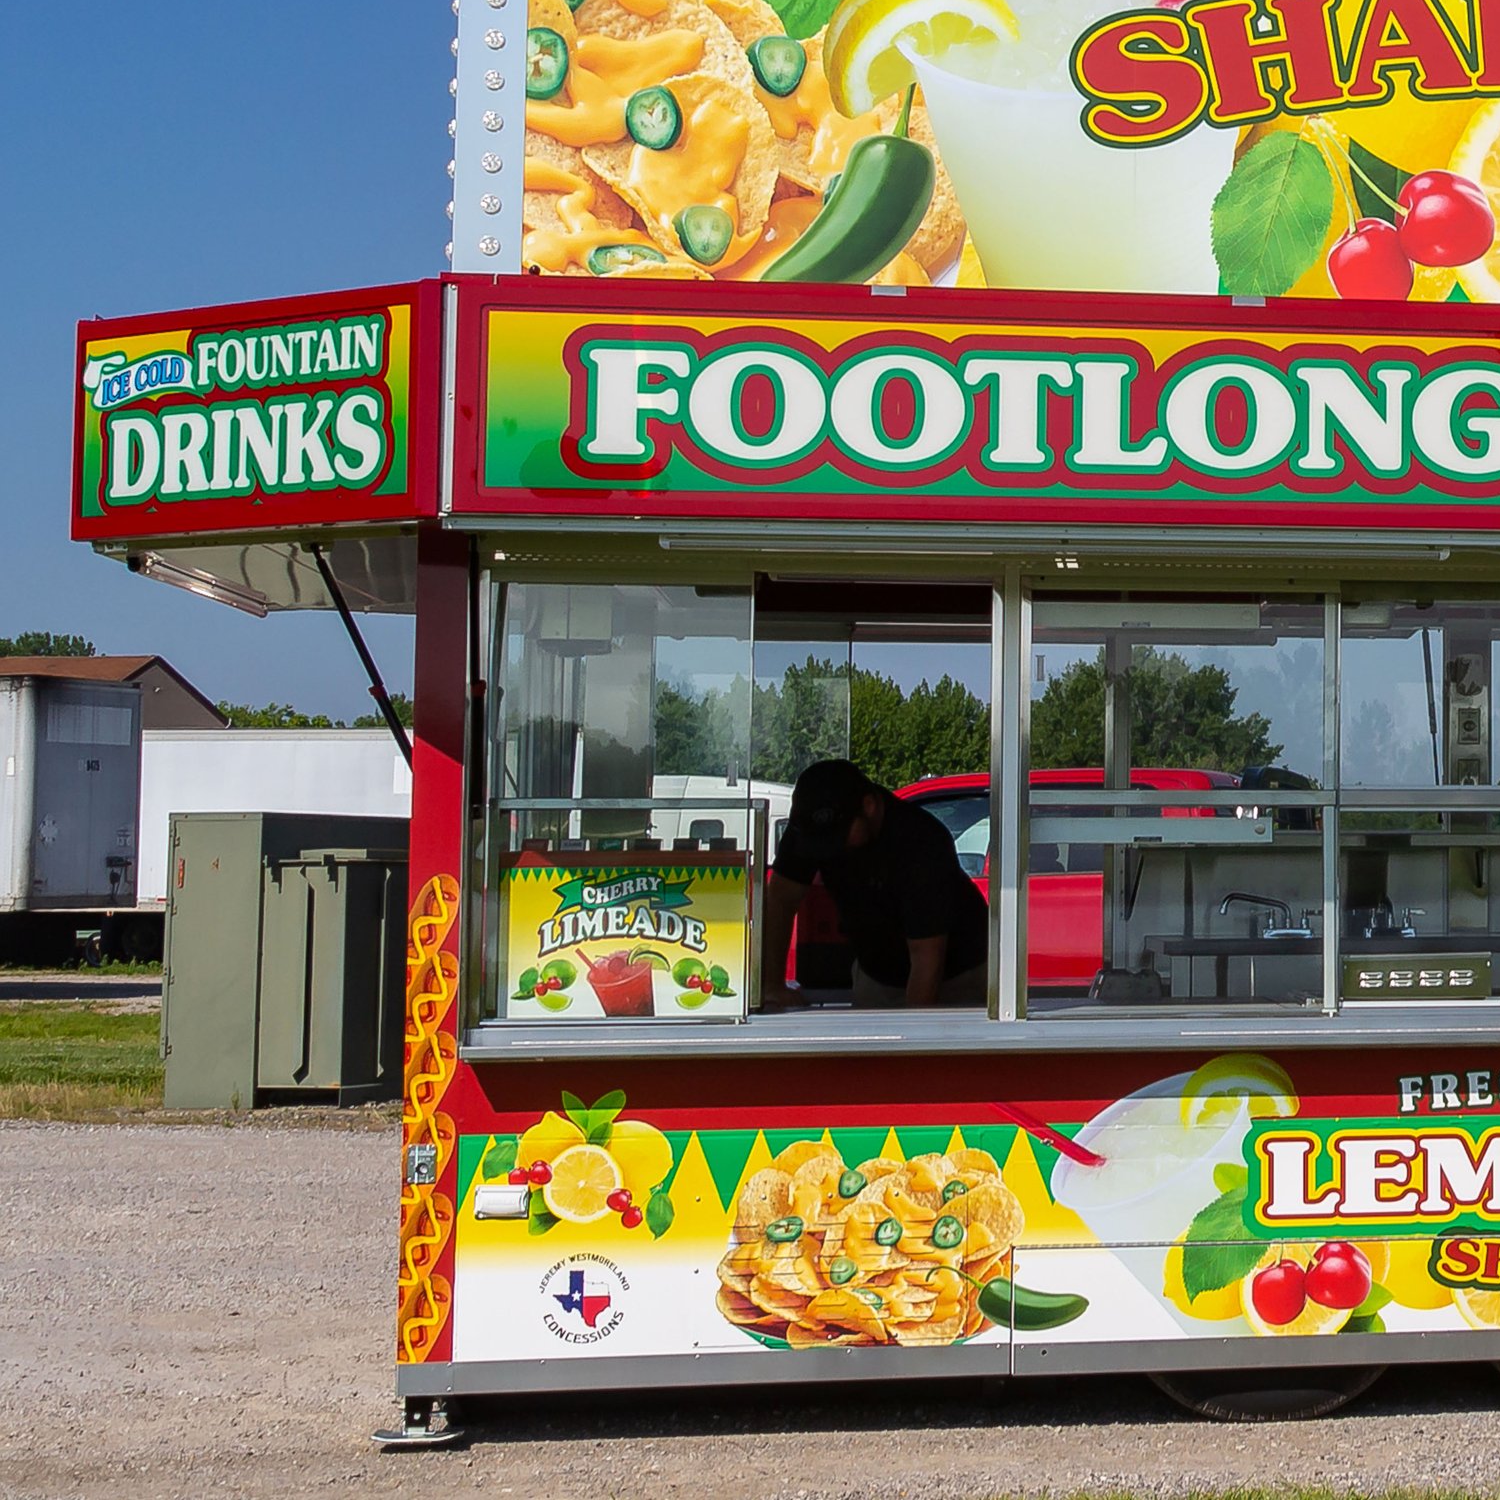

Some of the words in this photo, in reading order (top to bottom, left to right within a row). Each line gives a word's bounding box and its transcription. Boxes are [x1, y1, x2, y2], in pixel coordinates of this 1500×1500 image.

[197, 322, 380, 387] FOUNTAIN
[100, 370, 132, 405] ICE
[134, 356, 185, 392] COLD
[109, 394, 381, 498] DRINKS
[582, 876, 662, 904] CHERRY
[539, 905, 708, 956] LIMEADE
[538, 1258, 566, 1295] JEREMY
[568, 1252, 631, 1292] WESTMORELAND
[543, 1311, 625, 1345] CONCESSIONS
